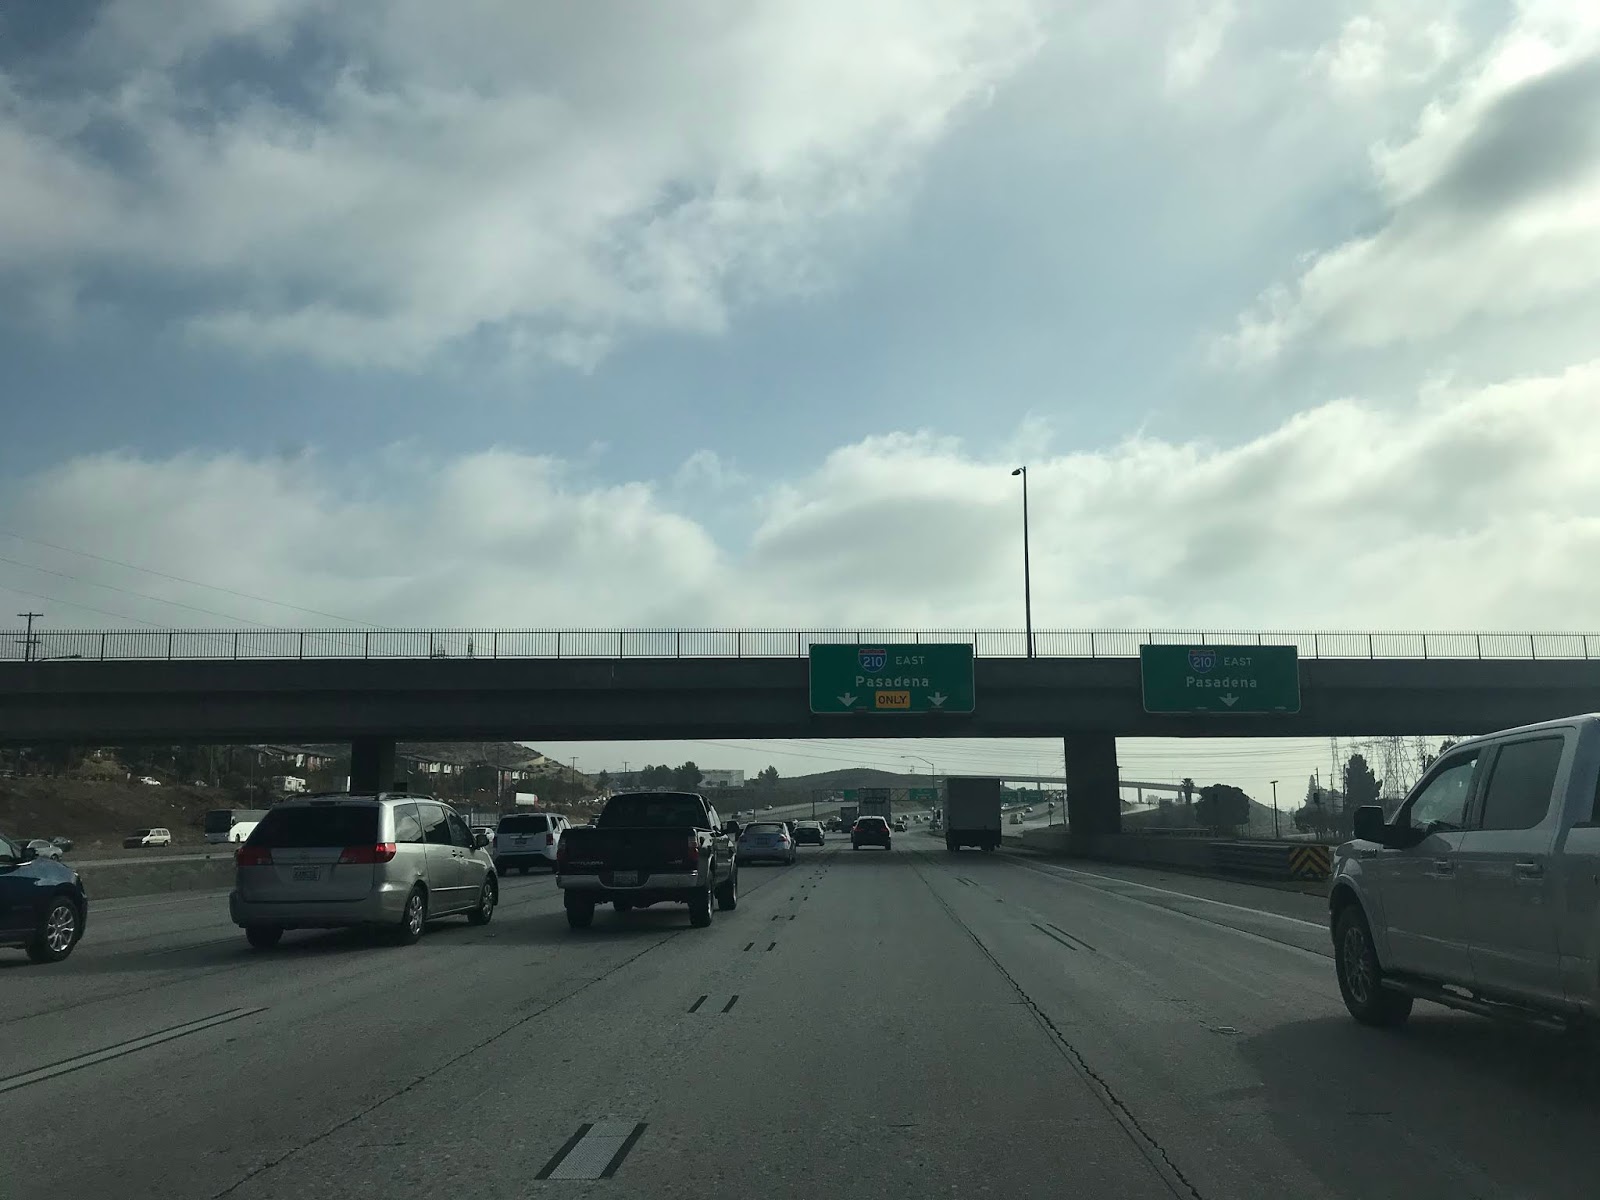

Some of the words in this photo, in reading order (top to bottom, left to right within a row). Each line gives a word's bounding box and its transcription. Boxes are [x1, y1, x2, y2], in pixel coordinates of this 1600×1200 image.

[863, 656, 883, 668] 210
[896, 656, 925, 665] EAST
[1193, 657, 1212, 668] 210
[1223, 657, 1252, 666] EAST
[855, 675, 929, 687] Pasadena
[1186, 676, 1257, 688] Pasadena
[878, 695, 907, 705] ONLY
